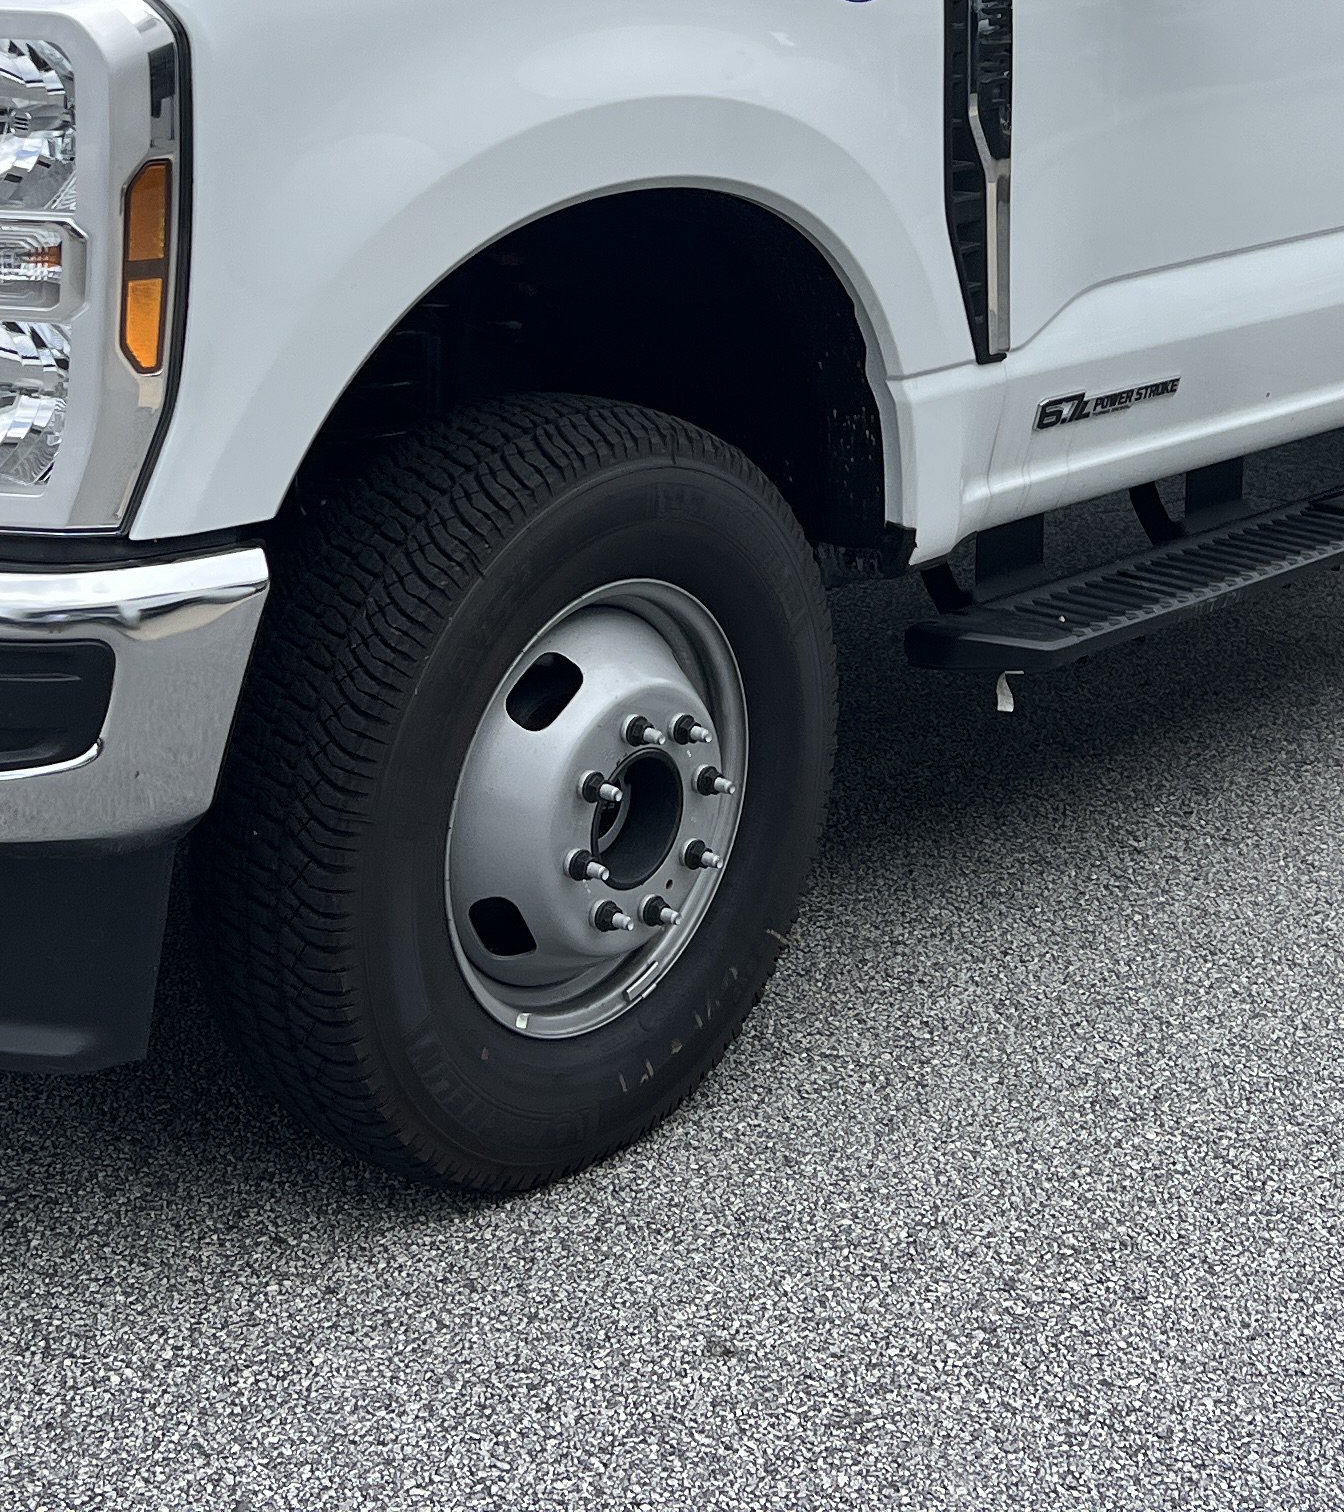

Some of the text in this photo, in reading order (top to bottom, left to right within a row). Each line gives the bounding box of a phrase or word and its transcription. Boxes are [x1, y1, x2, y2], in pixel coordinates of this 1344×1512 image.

[1036, 378, 1180, 430] 6.7L POWER STROKE
